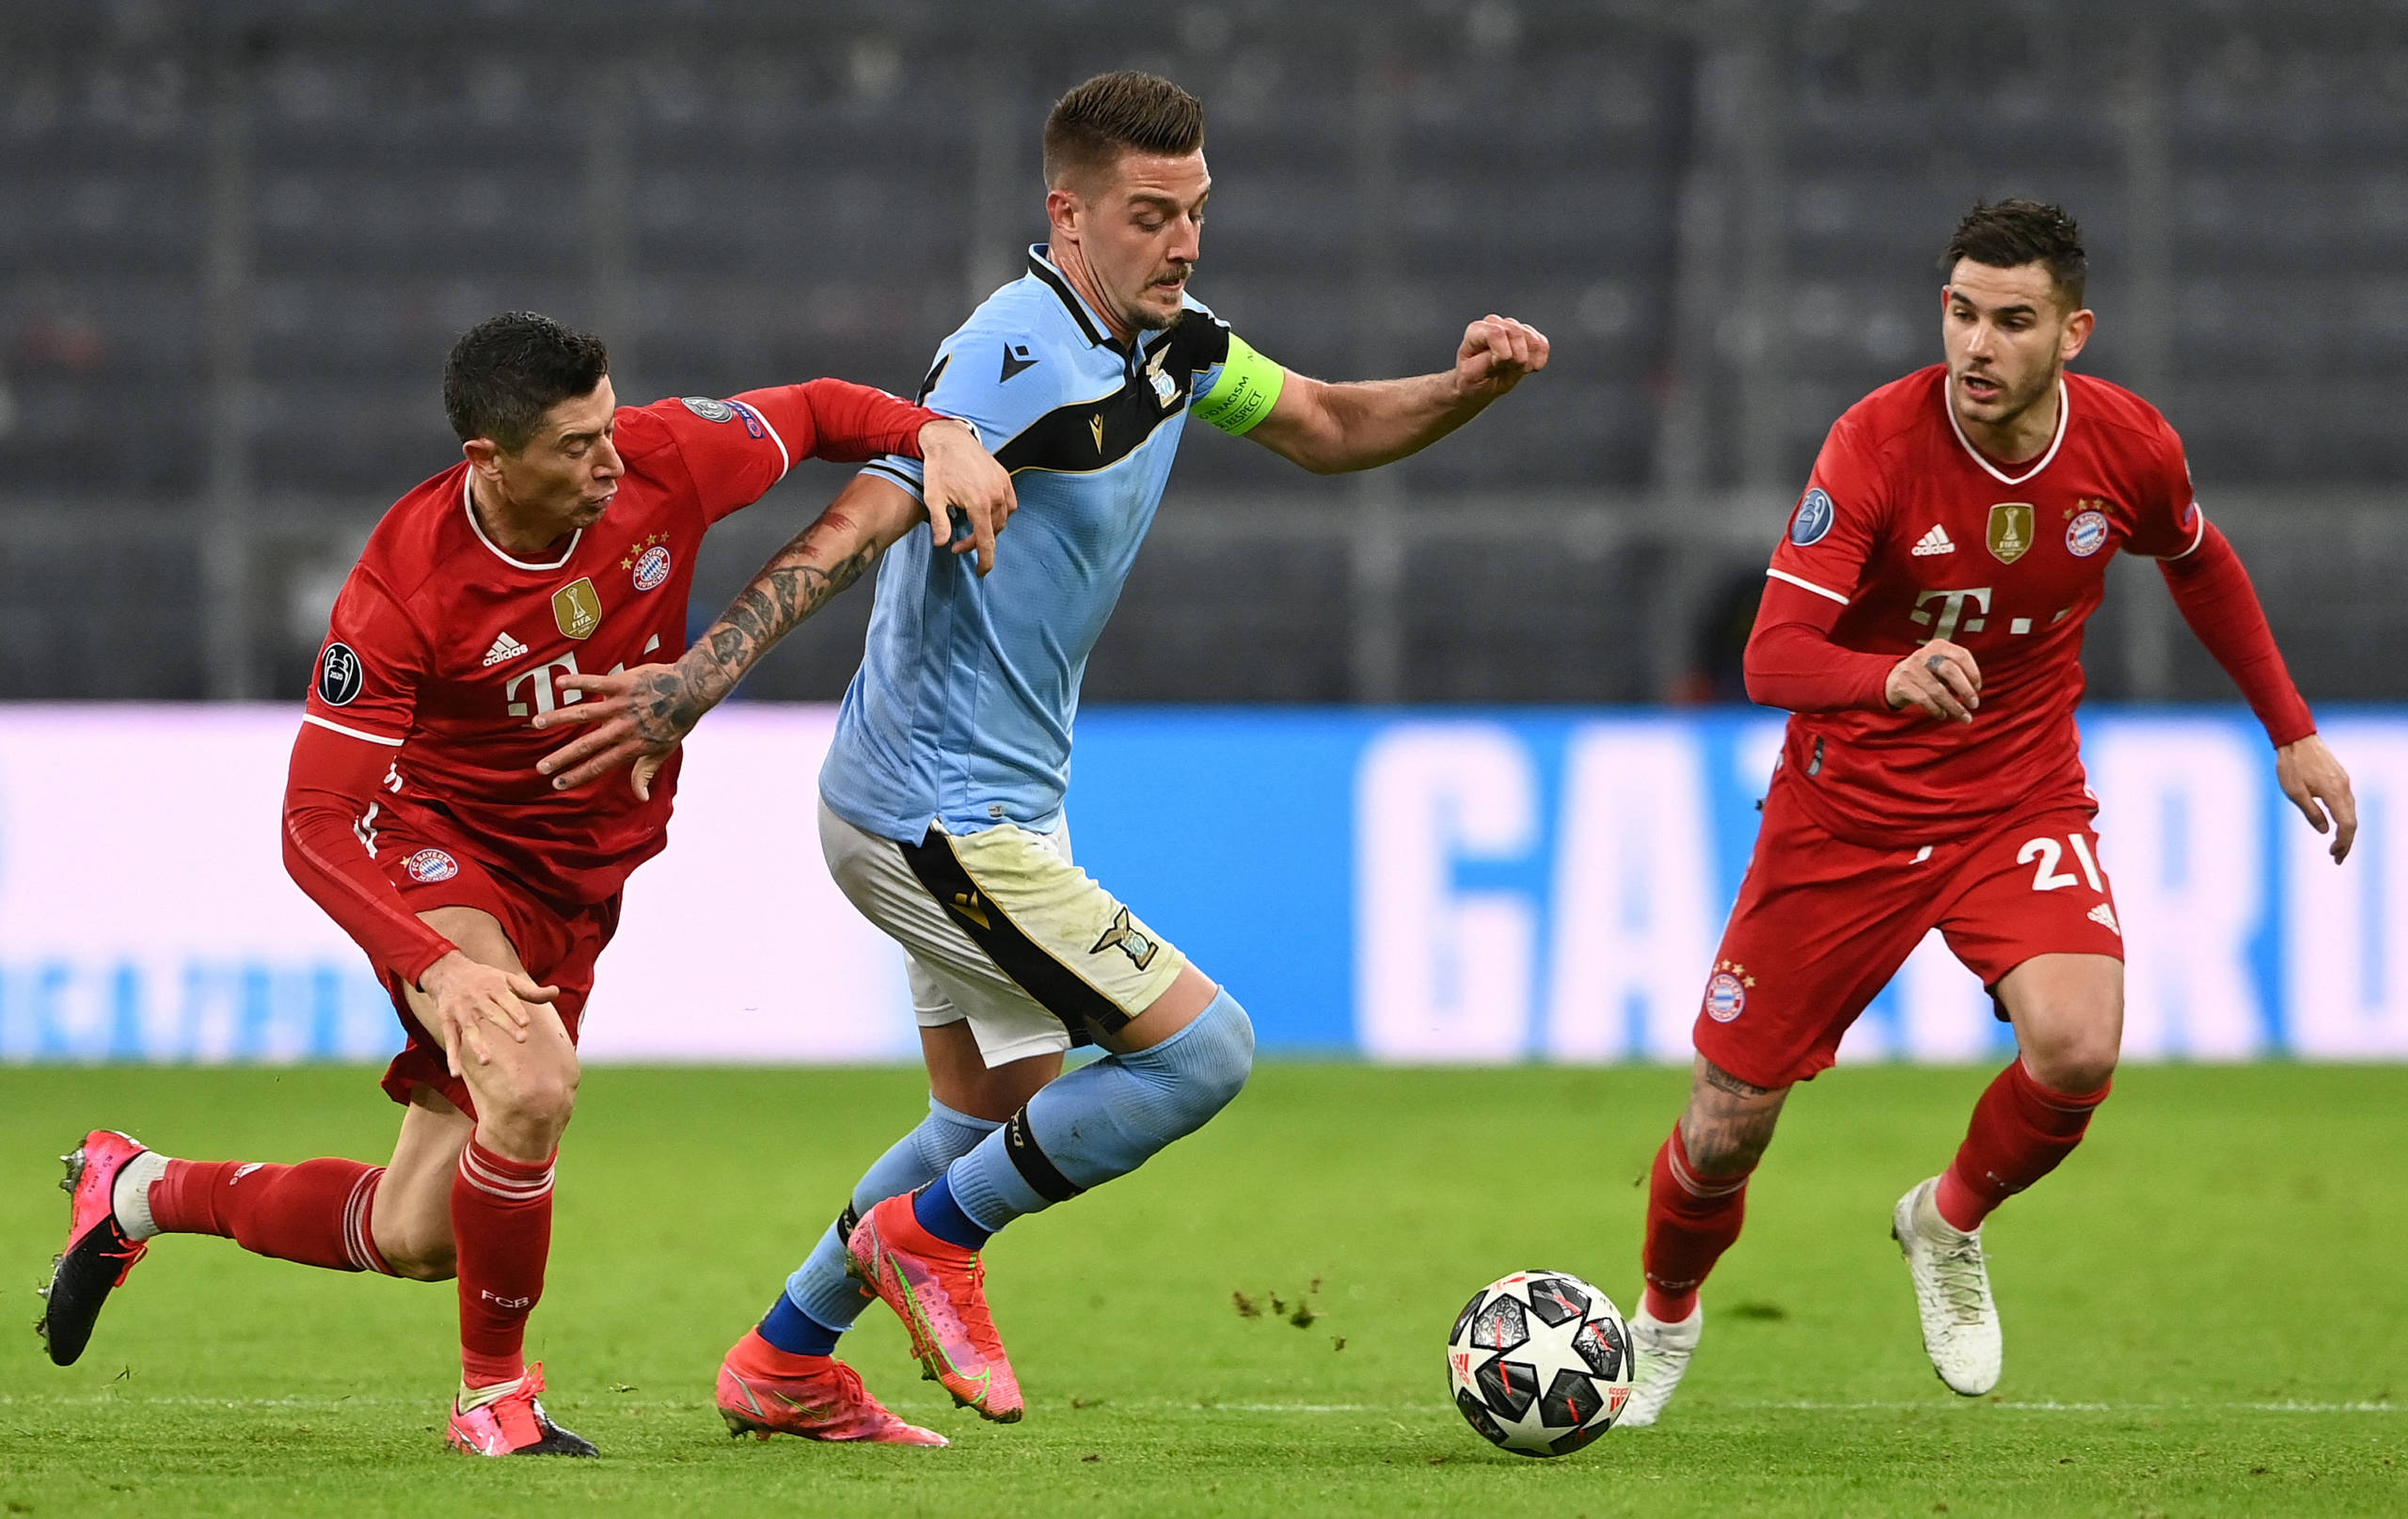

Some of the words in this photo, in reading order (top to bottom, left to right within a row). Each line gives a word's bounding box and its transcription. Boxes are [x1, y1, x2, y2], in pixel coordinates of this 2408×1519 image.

[1218, 376, 1249, 412] RACISM
[1226, 390, 1262, 425] RESPECT
[572, 615, 592, 629] FIFA
[483, 643, 529, 667] adidas
[330, 671, 343, 681] 2020
[416, 851, 450, 862] BAYERN
[2016, 833, 2103, 894] 21
[482, 1290, 530, 1308] FCB
